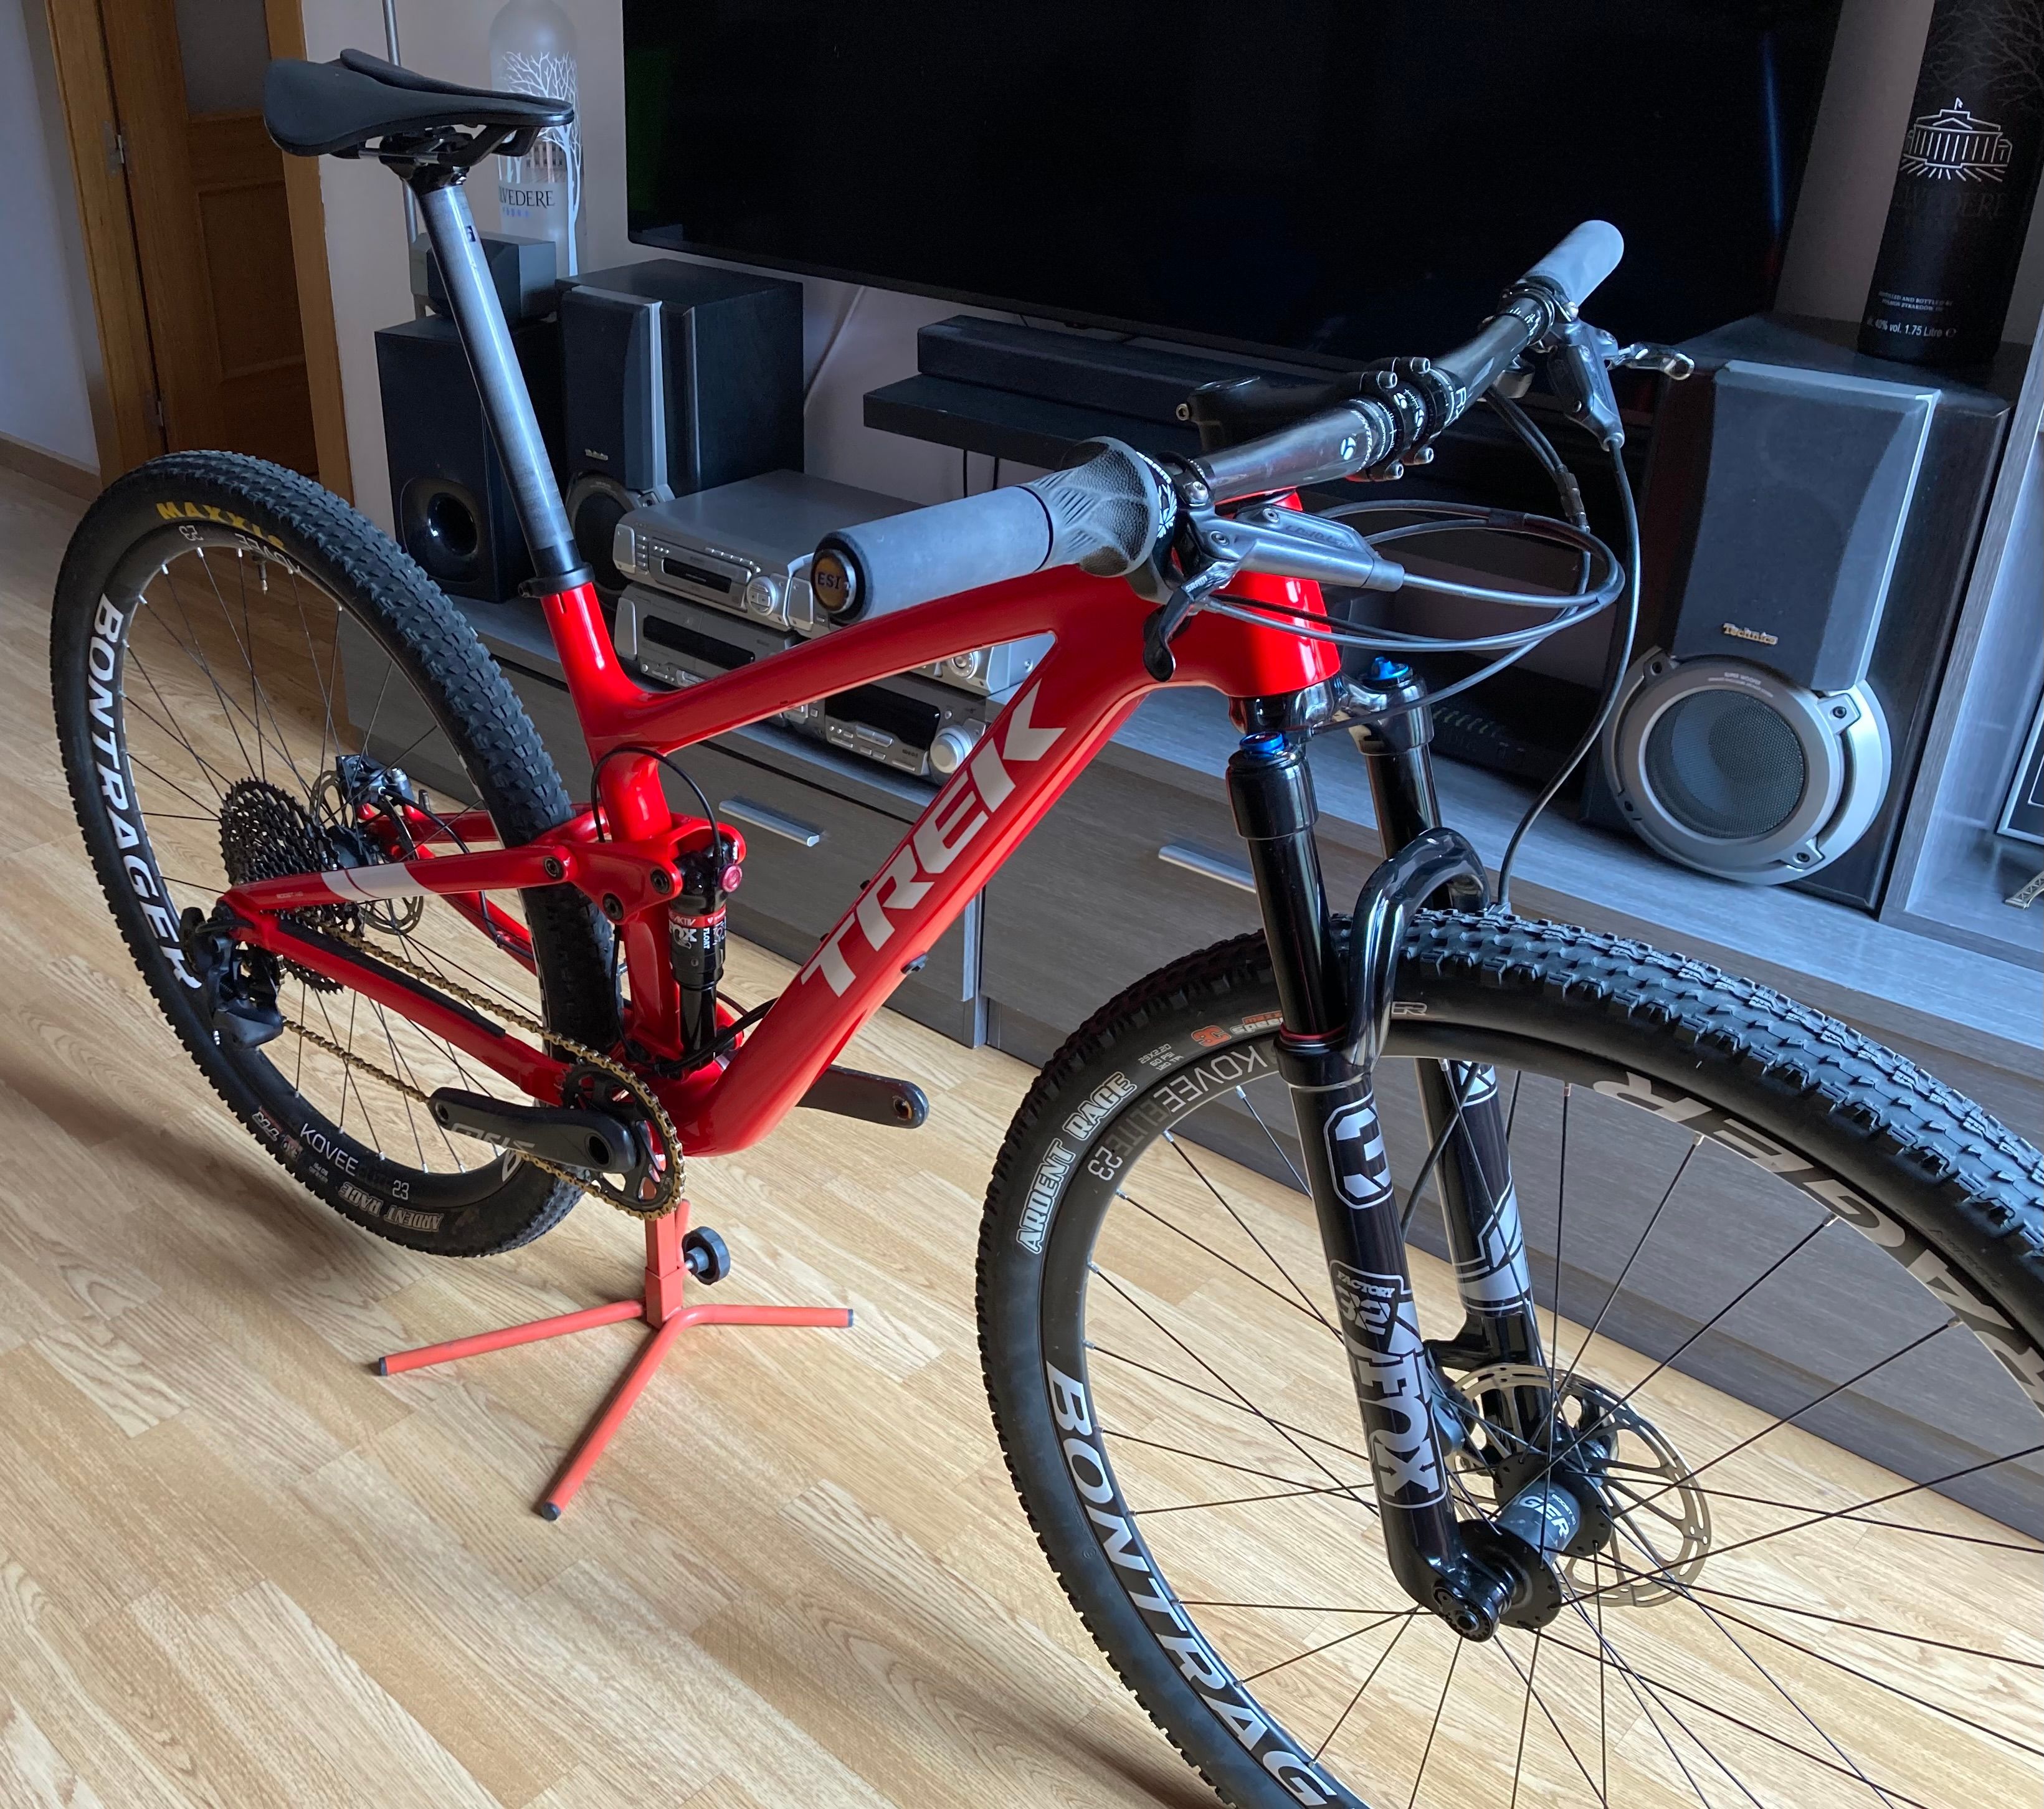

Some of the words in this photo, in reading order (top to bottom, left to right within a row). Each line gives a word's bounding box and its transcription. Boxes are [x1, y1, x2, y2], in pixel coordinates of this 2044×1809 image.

[1905, 324, 1923, 336] 1.75
[817, 572, 842, 590] ESI
[1185, 575, 1208, 592] SRAM
[1723, 622, 1779, 645] Technics
[800, 678, 1067, 998] TREK
[703, 927, 711, 949] FLOAT
[1149, 1058, 1162, 1067] 60
[1160, 1052, 1175, 1061] PSI
[1156, 1061, 1171, 1071] 120
[1154, 1045, 1268, 1114] KOVEE
[1105, 1098, 1169, 1157] ELITE
[300, 1123, 359, 1177] KOVEE
[392, 1179, 410, 1201] 23
[1016, 1137, 1077, 1254] ARDENT
[1062, 1071, 1138, 1141] RACE
[1088, 1146, 1123, 1181] 23
[338, 1180, 384, 1217] RACE
[383, 1205, 445, 1233] ARDENT
[1337, 1270, 1395, 1299] FACTORY
[1336, 1284, 1392, 1336] 32
[1356, 1349, 1440, 1498] FOX
[1551, 1493, 1573, 1516] BOOST
